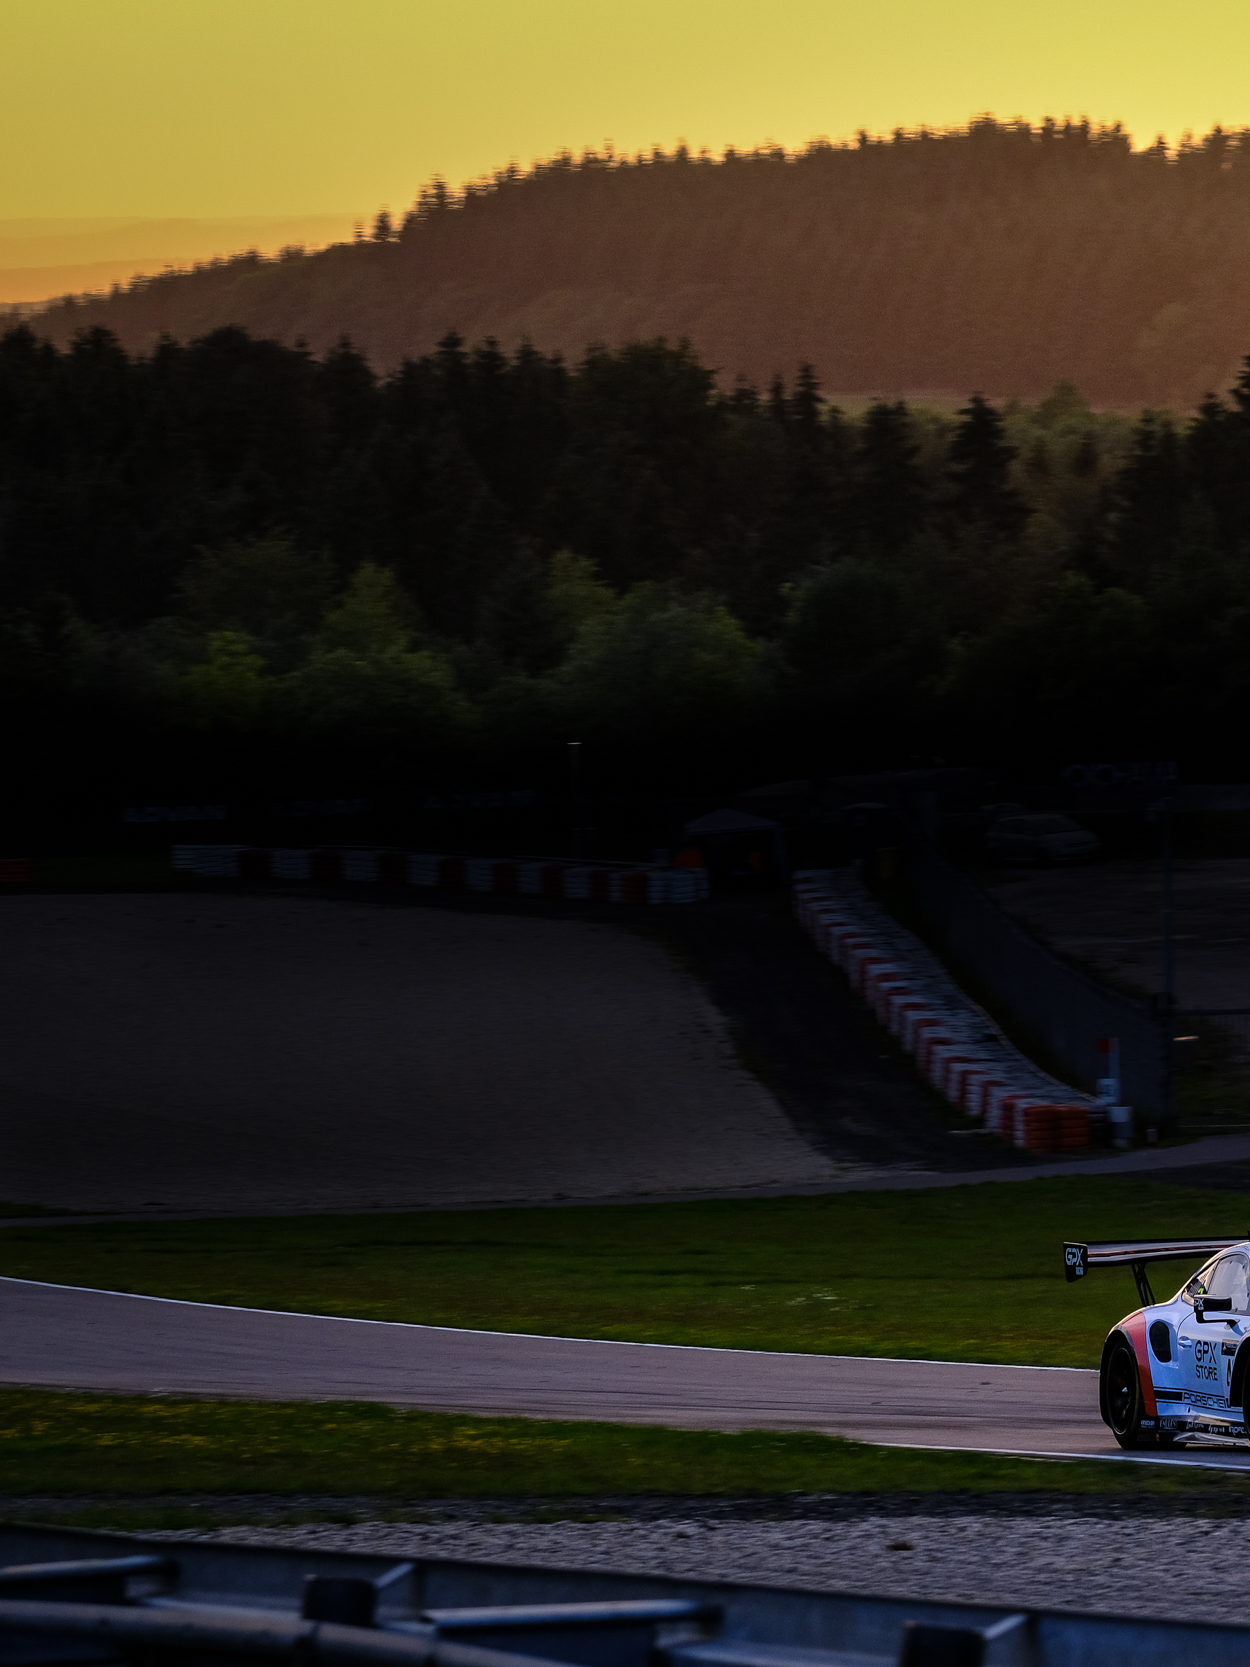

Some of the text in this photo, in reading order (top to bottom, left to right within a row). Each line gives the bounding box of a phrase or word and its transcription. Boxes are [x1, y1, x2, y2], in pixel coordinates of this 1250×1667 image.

[1065, 1247, 1084, 1266] GPX
[1194, 1340, 1218, 1364] GPX
[1195, 1364, 1219, 1381] STORE
